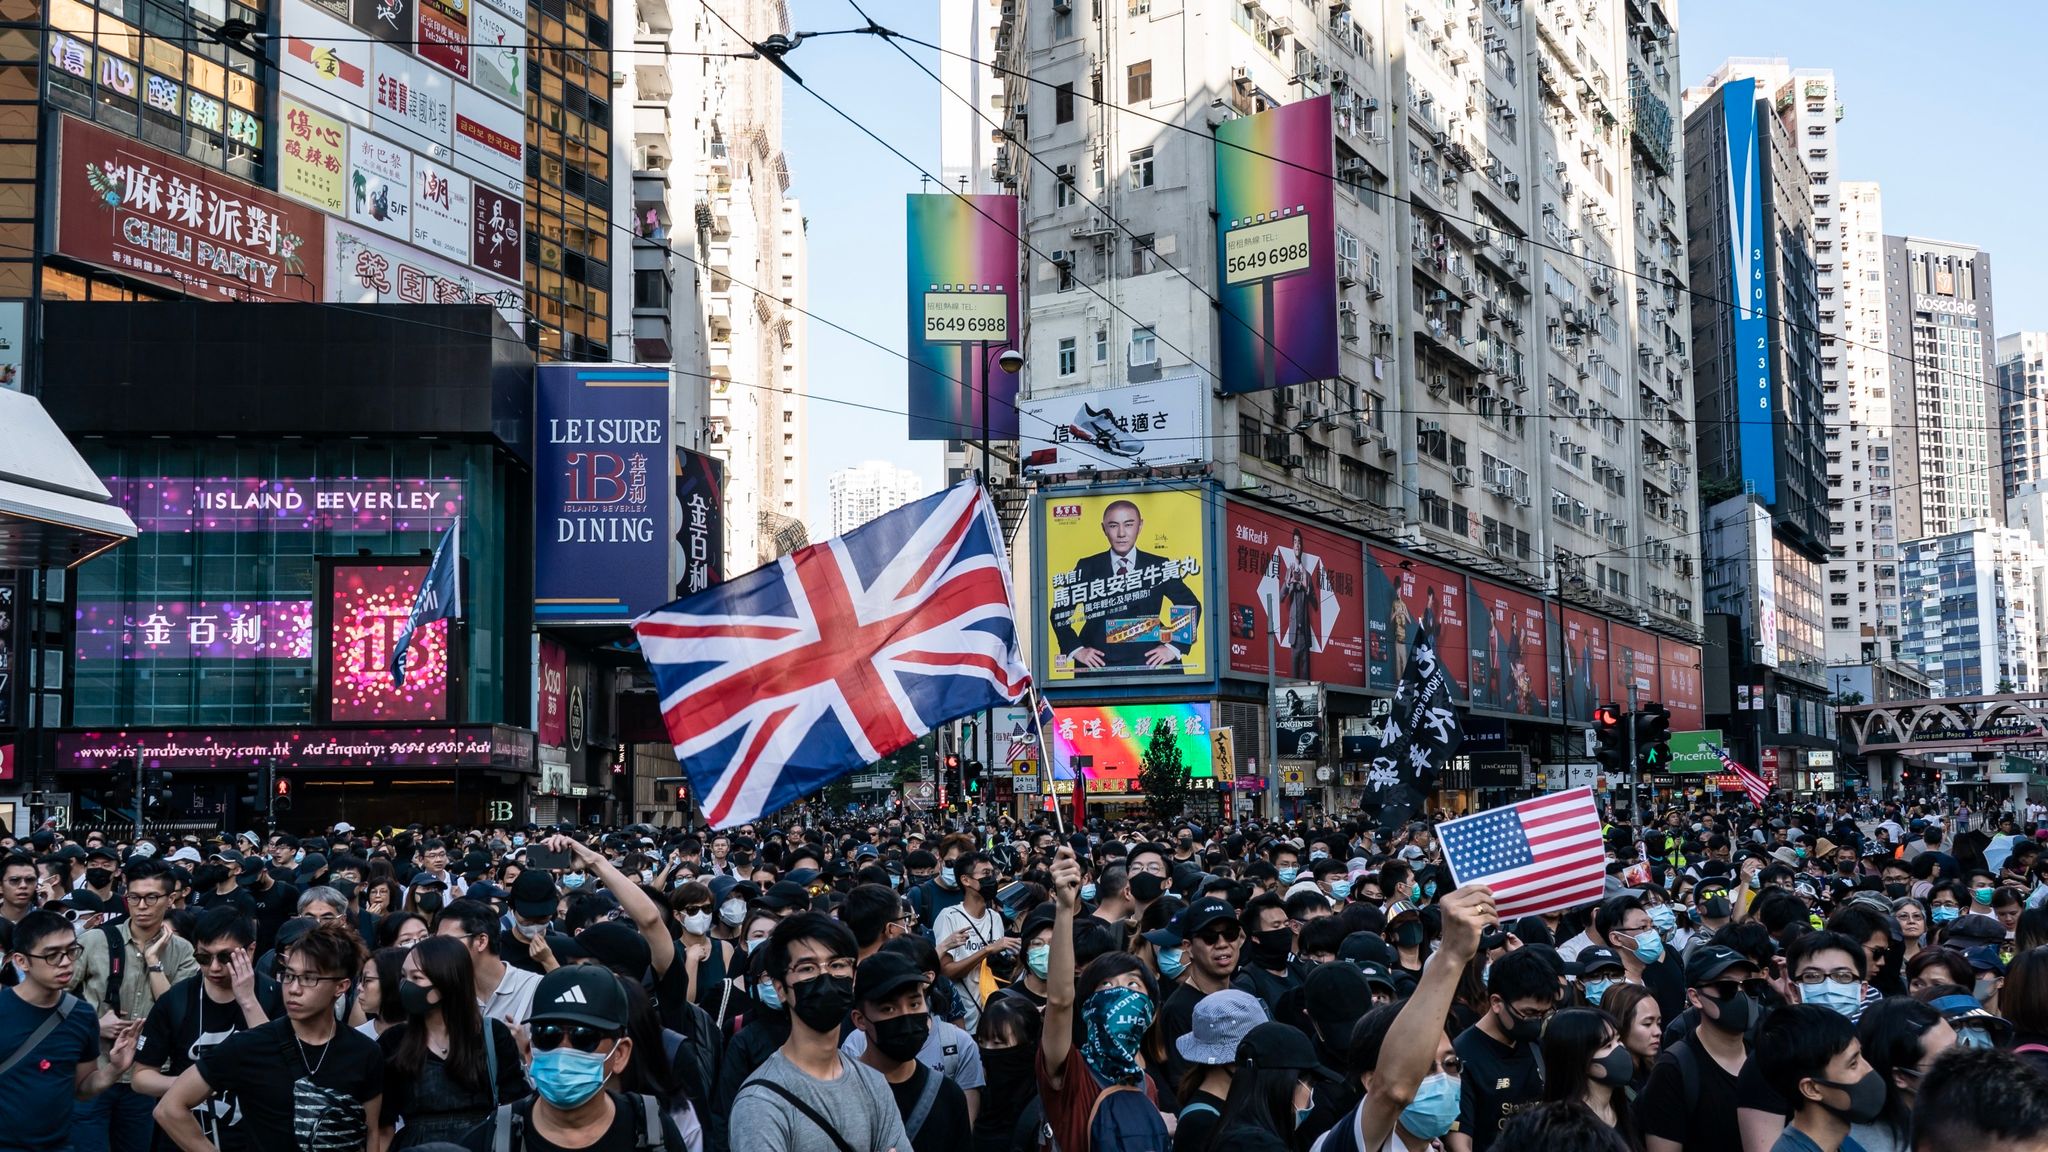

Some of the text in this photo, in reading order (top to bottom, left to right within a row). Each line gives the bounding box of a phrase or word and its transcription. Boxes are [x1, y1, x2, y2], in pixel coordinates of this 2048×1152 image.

[508, 180, 521, 192] 6/F
[122, 164, 281, 255] 麻辣派對
[327, 198, 342, 209] 5/F
[390, 201, 408, 216] 5/F
[414, 228, 429, 240] 5/F
[122, 216, 279, 289] CHILI PARTY
[1228, 242, 1308, 274] 5649 6988
[493, 259, 503, 270] 5F
[1754, 249, 1764, 319] 3602
[1916, 292, 1977, 316] Rosedale
[927, 317, 1006, 332] 5649 6988
[1757, 338, 1768, 409] 2388
[550, 419, 662, 444] LEISURE
[205, 492, 441, 510] ISLAND BEVERLEY
[563, 505, 649, 513] ISLAND BEVERLEY
[557, 518, 655, 543] DINING
[686, 493, 710, 593] 金百利
[138, 613, 263, 646] 金百利
[1276, 720, 1314, 729] LONGINES
[81, 741, 291, 760] www.isandbeverley.com.hk
